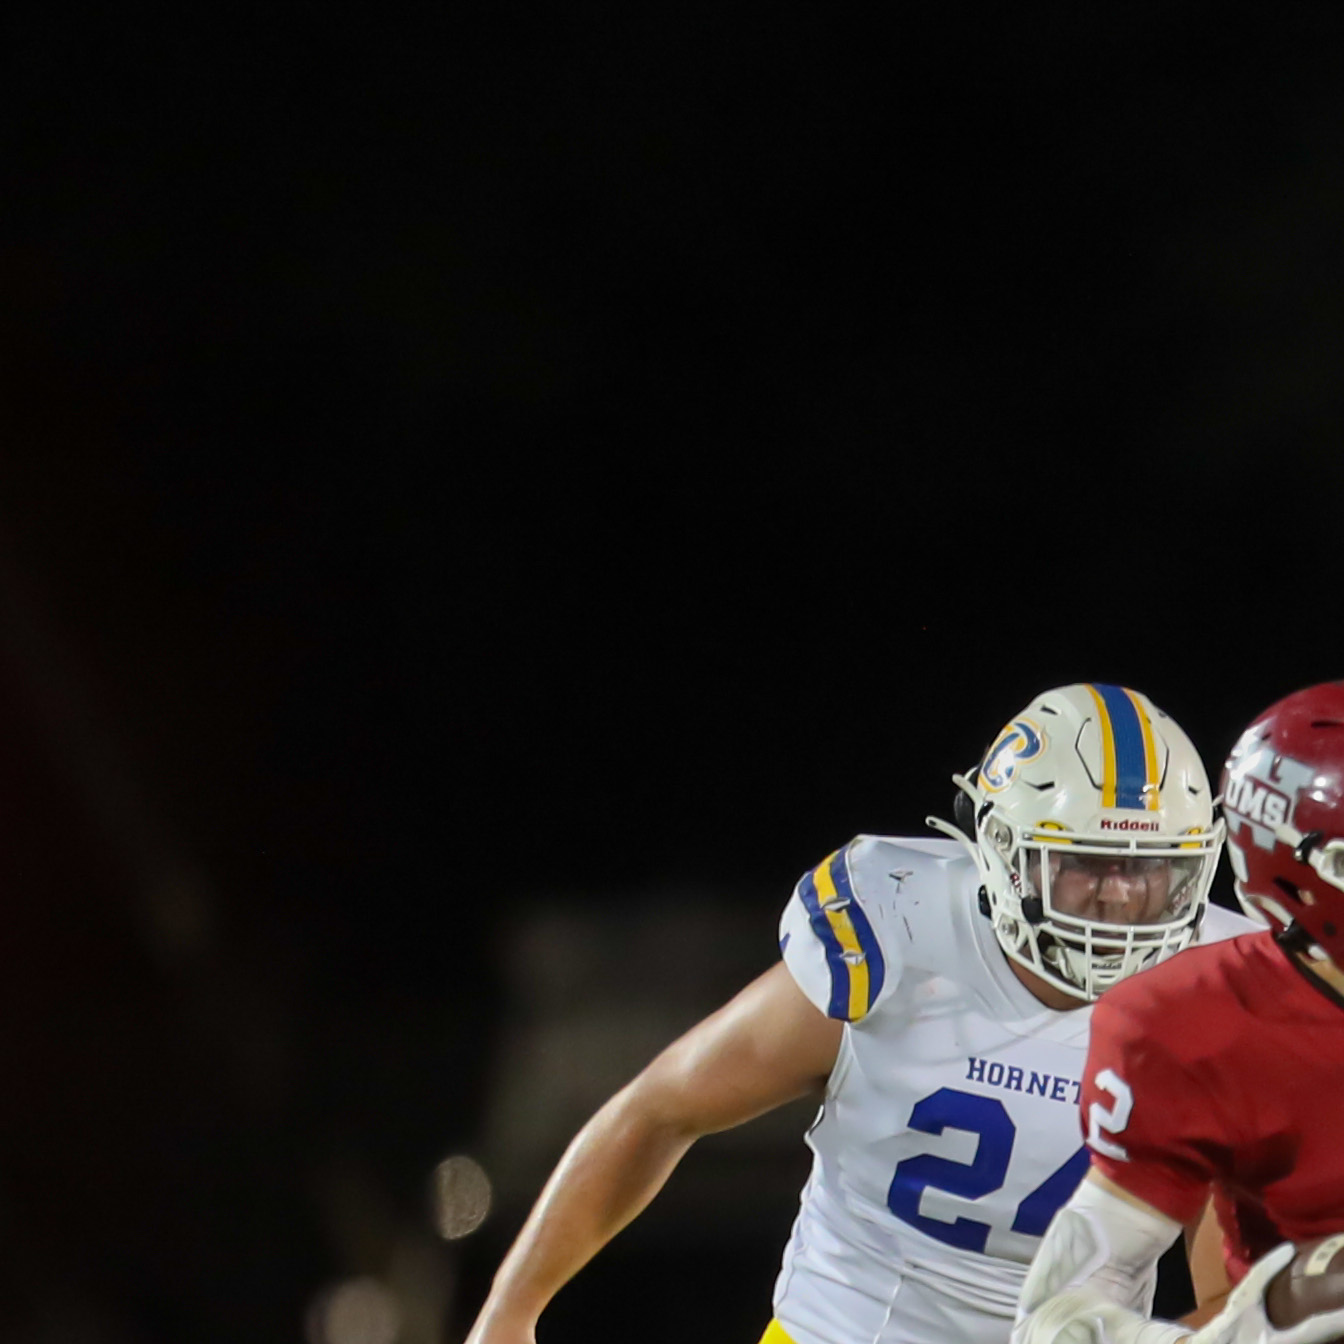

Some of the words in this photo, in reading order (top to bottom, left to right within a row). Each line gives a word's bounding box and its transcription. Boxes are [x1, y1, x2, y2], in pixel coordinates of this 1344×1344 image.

[1100, 819, 1160, 832] Riddell
[966, 1057, 1081, 1106] HORNET
[1086, 1069, 1135, 1163] 2
